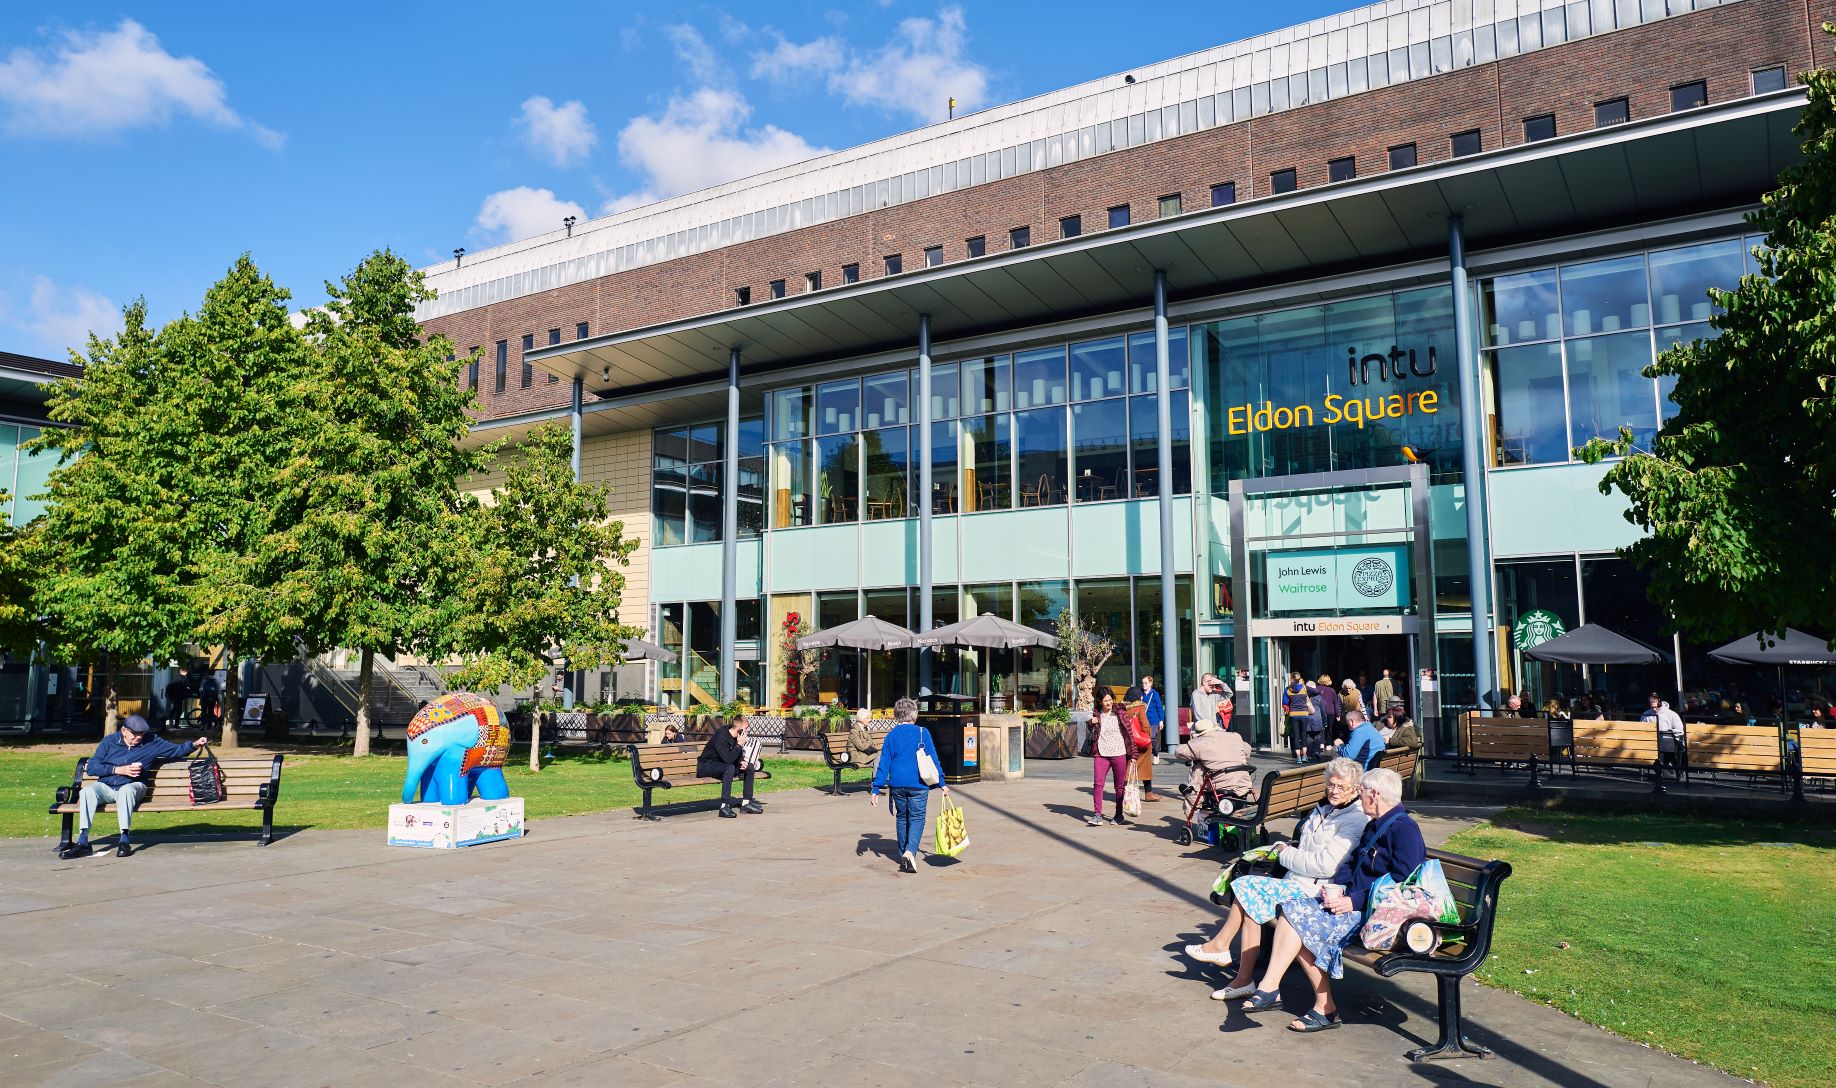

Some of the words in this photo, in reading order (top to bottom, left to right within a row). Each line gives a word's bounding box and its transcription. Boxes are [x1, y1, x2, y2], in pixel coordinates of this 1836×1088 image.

[1348, 345, 1437, 386] intu
[1228, 401, 1313, 435] Eldon
[1323, 390, 1438, 429] Square
[1278, 566, 1299, 579] John
[1301, 565, 1327, 576] Lewis
[1278, 583, 1327, 593] Waitrose
[1293, 621, 1316, 632] intu
[1318, 622, 1345, 632] Eldon
[1346, 621, 1380, 632] Square
